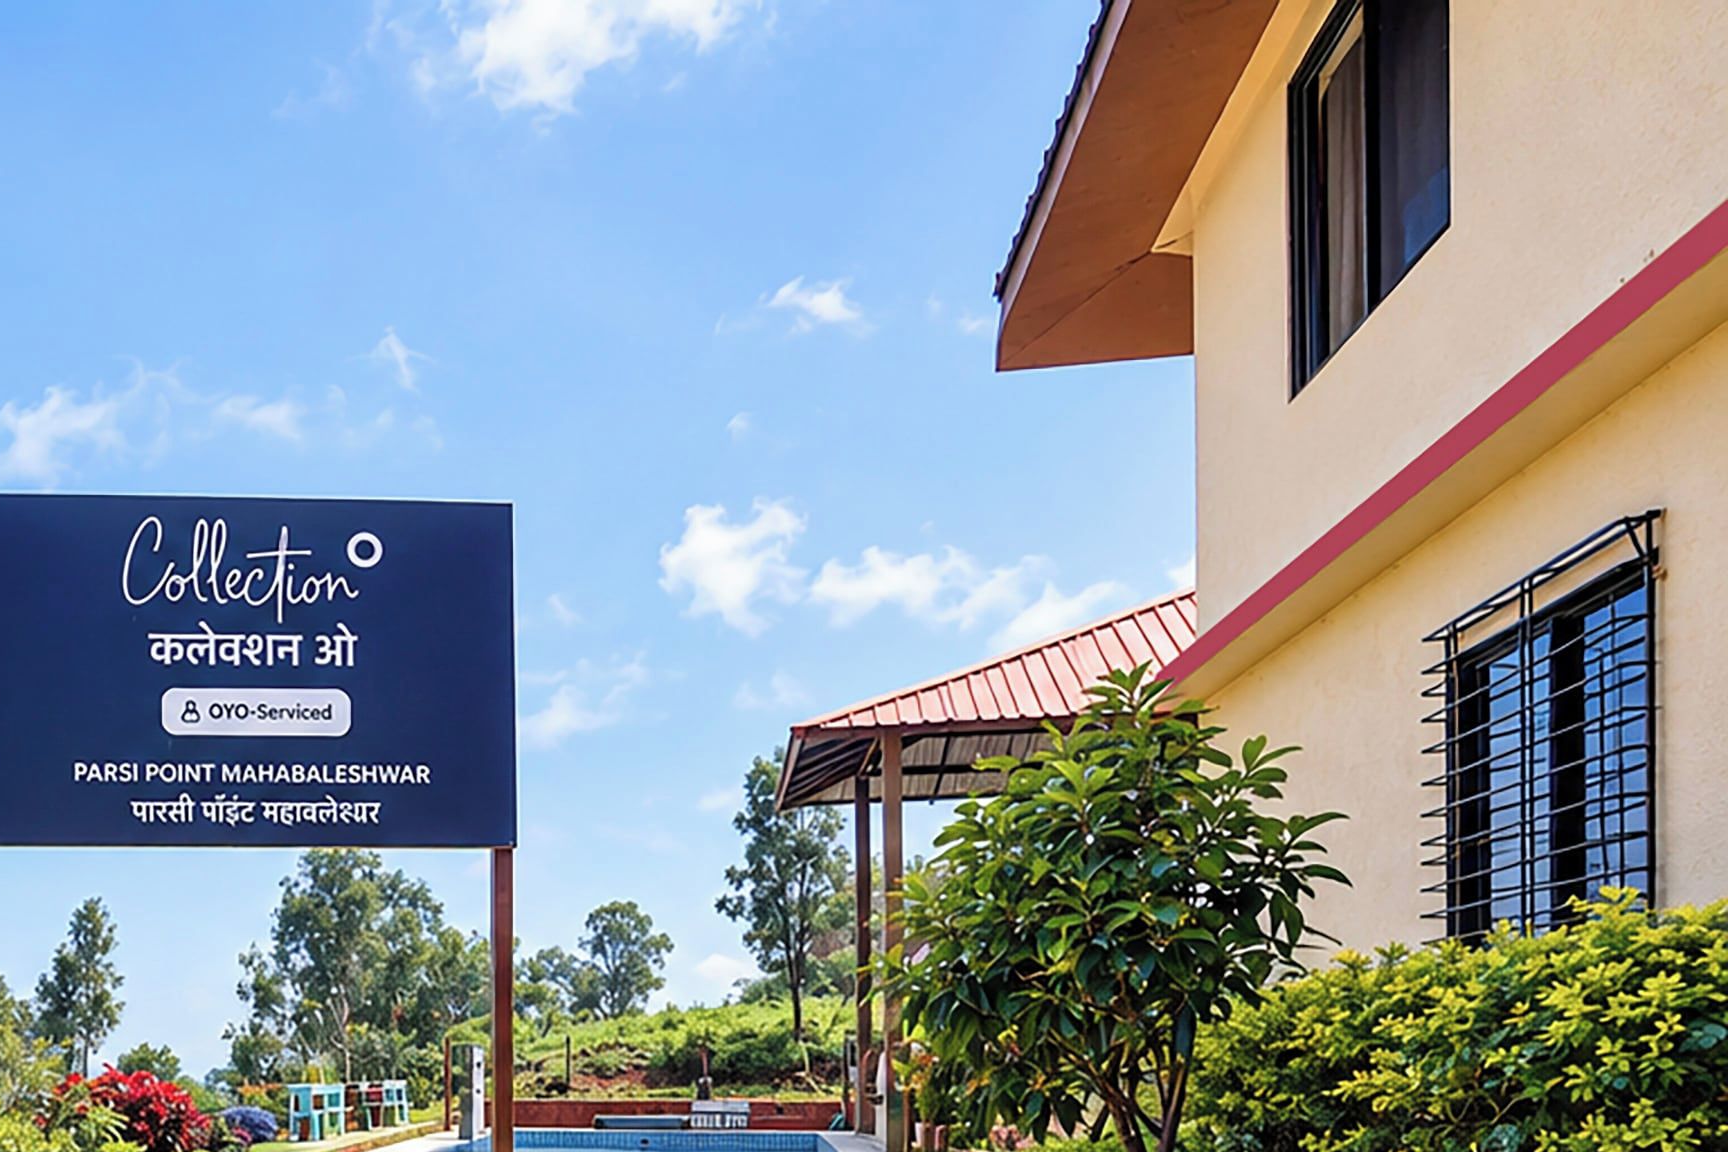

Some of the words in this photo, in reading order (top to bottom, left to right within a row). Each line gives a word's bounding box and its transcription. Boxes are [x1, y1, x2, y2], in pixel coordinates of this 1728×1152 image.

[122, 516, 359, 624] Collection
[314, 622, 359, 667] ओ
[208, 702, 333, 721] OYO-Serviced
[74, 762, 139, 783] PARSI
[145, 763, 216, 783] POINT
[221, 763, 431, 784] MAHABALESHWAR
[129, 792, 195, 823] पारसी
